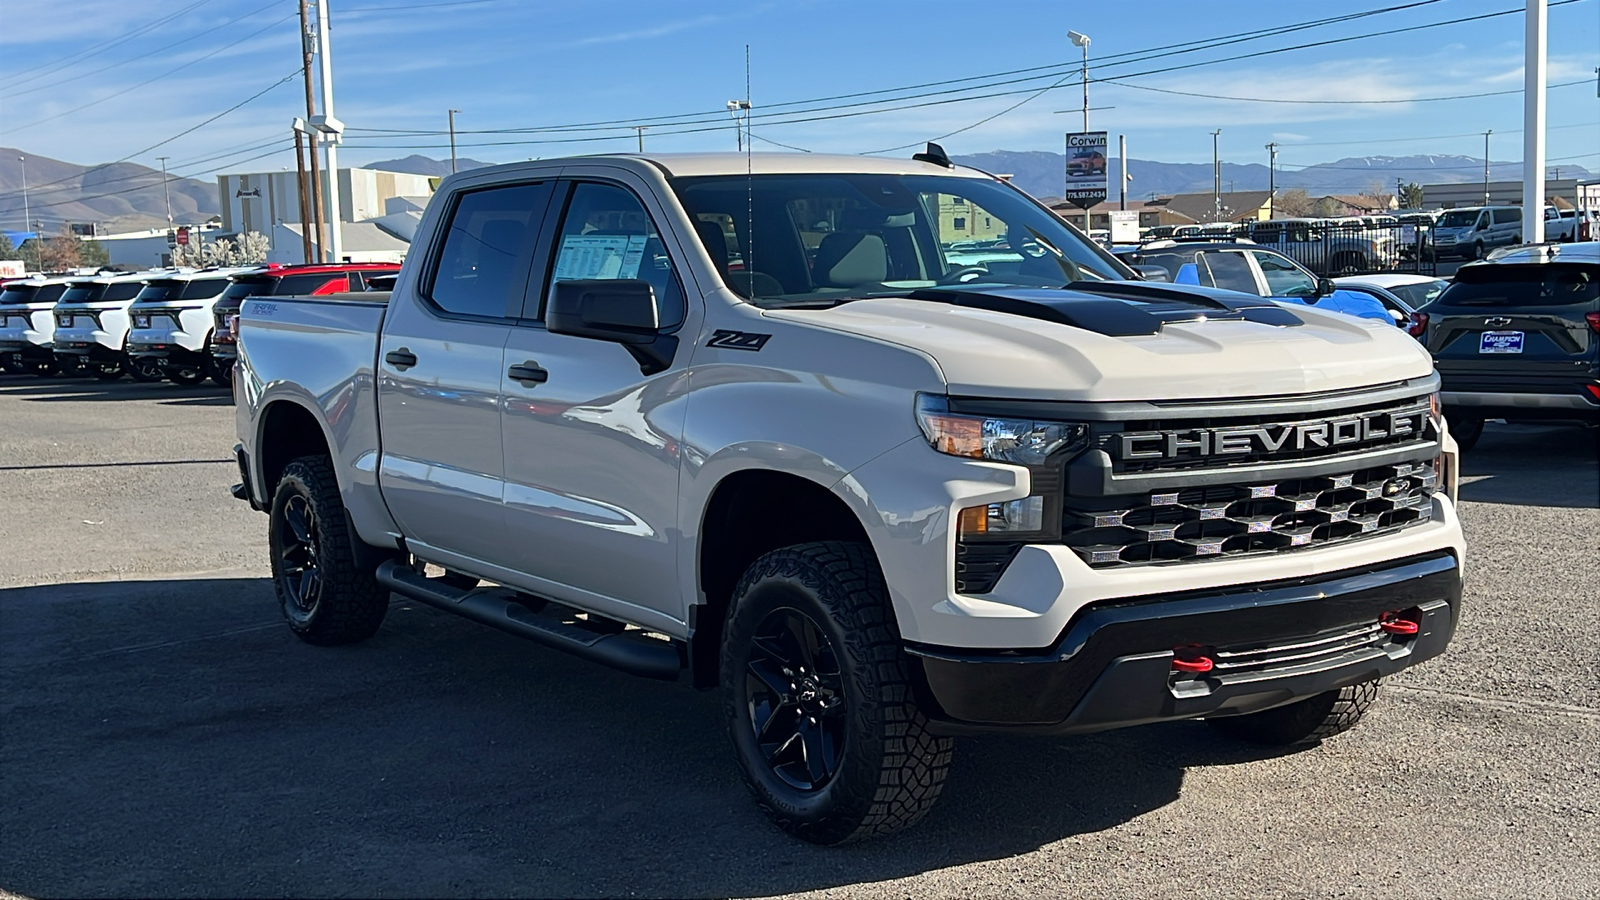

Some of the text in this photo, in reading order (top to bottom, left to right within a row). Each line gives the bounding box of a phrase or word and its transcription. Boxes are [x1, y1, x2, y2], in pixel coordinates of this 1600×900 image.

[1070, 136, 1106, 146] Corwin
[253, 303, 278, 311] TRAIL
[1484, 335, 1521, 343] CHAMPION
[1121, 408, 1432, 460] CHEVROLET
